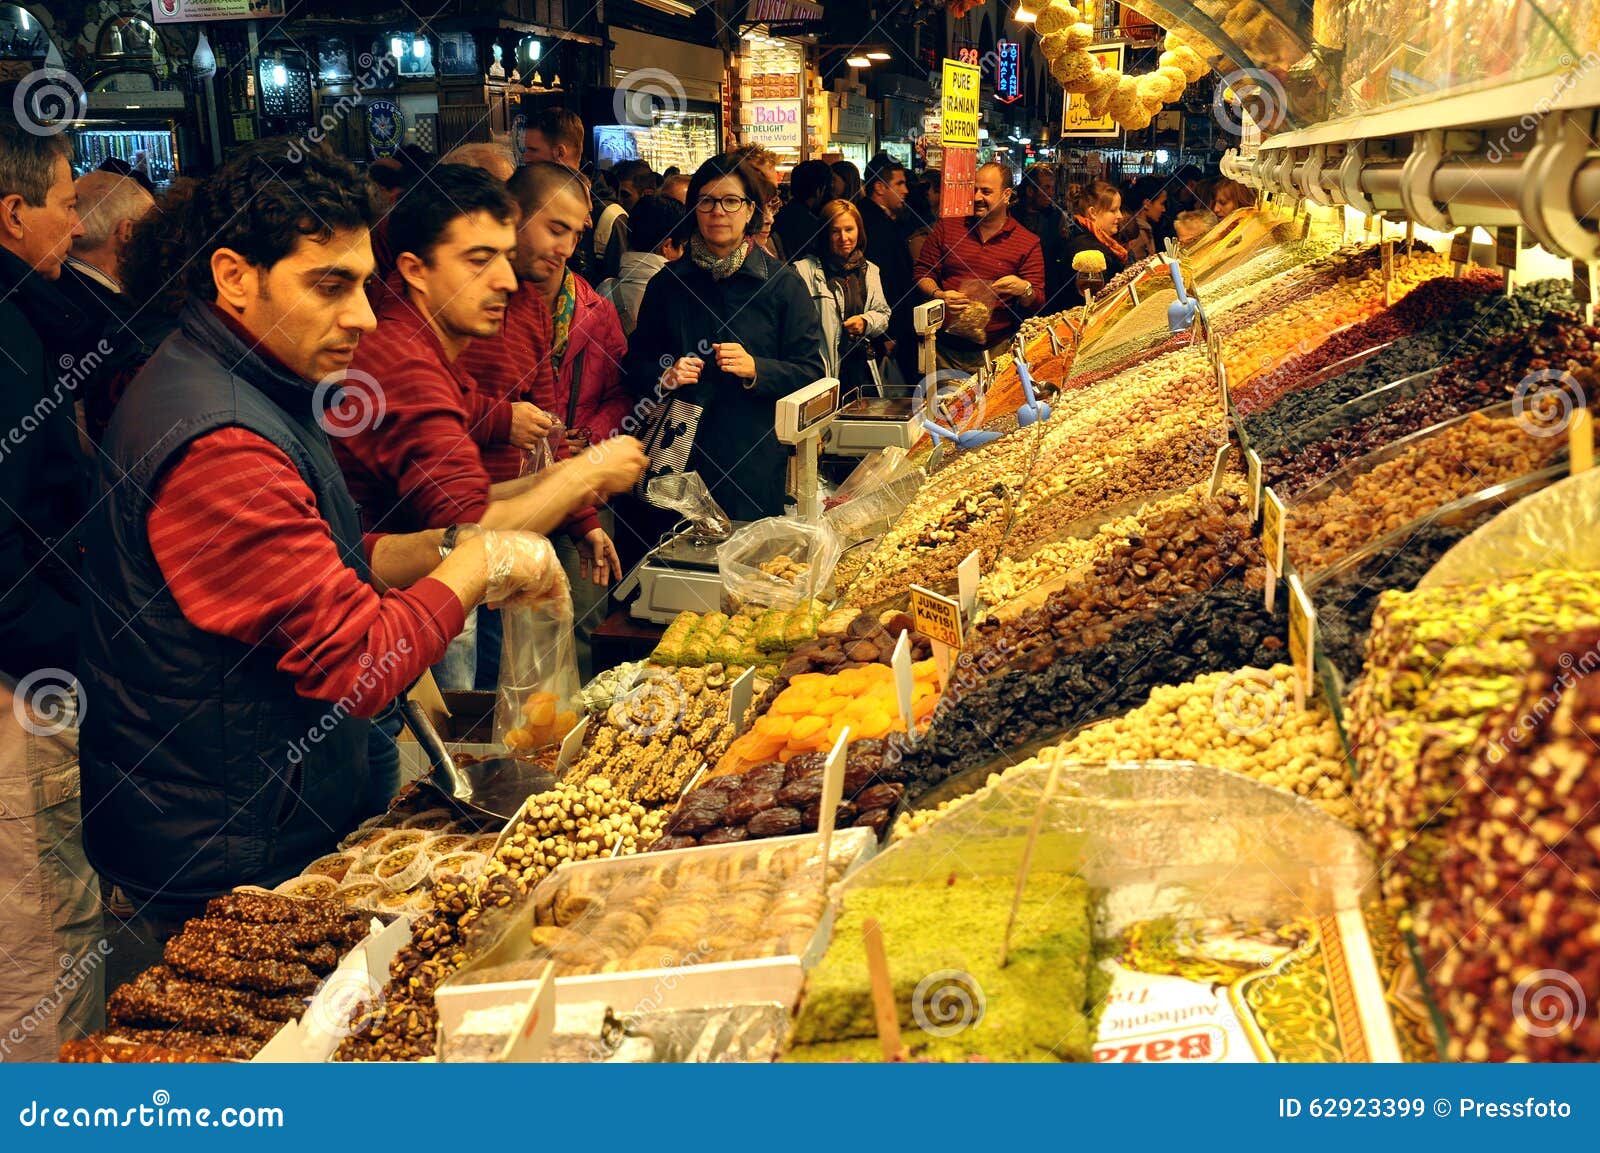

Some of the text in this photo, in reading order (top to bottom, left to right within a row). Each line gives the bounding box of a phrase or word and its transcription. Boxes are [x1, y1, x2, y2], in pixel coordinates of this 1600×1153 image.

[953, 72, 970, 90] PURE
[946, 95, 975, 114] IRANIAN
[774, 133, 797, 141] World
[945, 119, 976, 137] SAFFRON
[918, 595, 950, 616] JUMBO
[940, 627, 957, 645] 30
